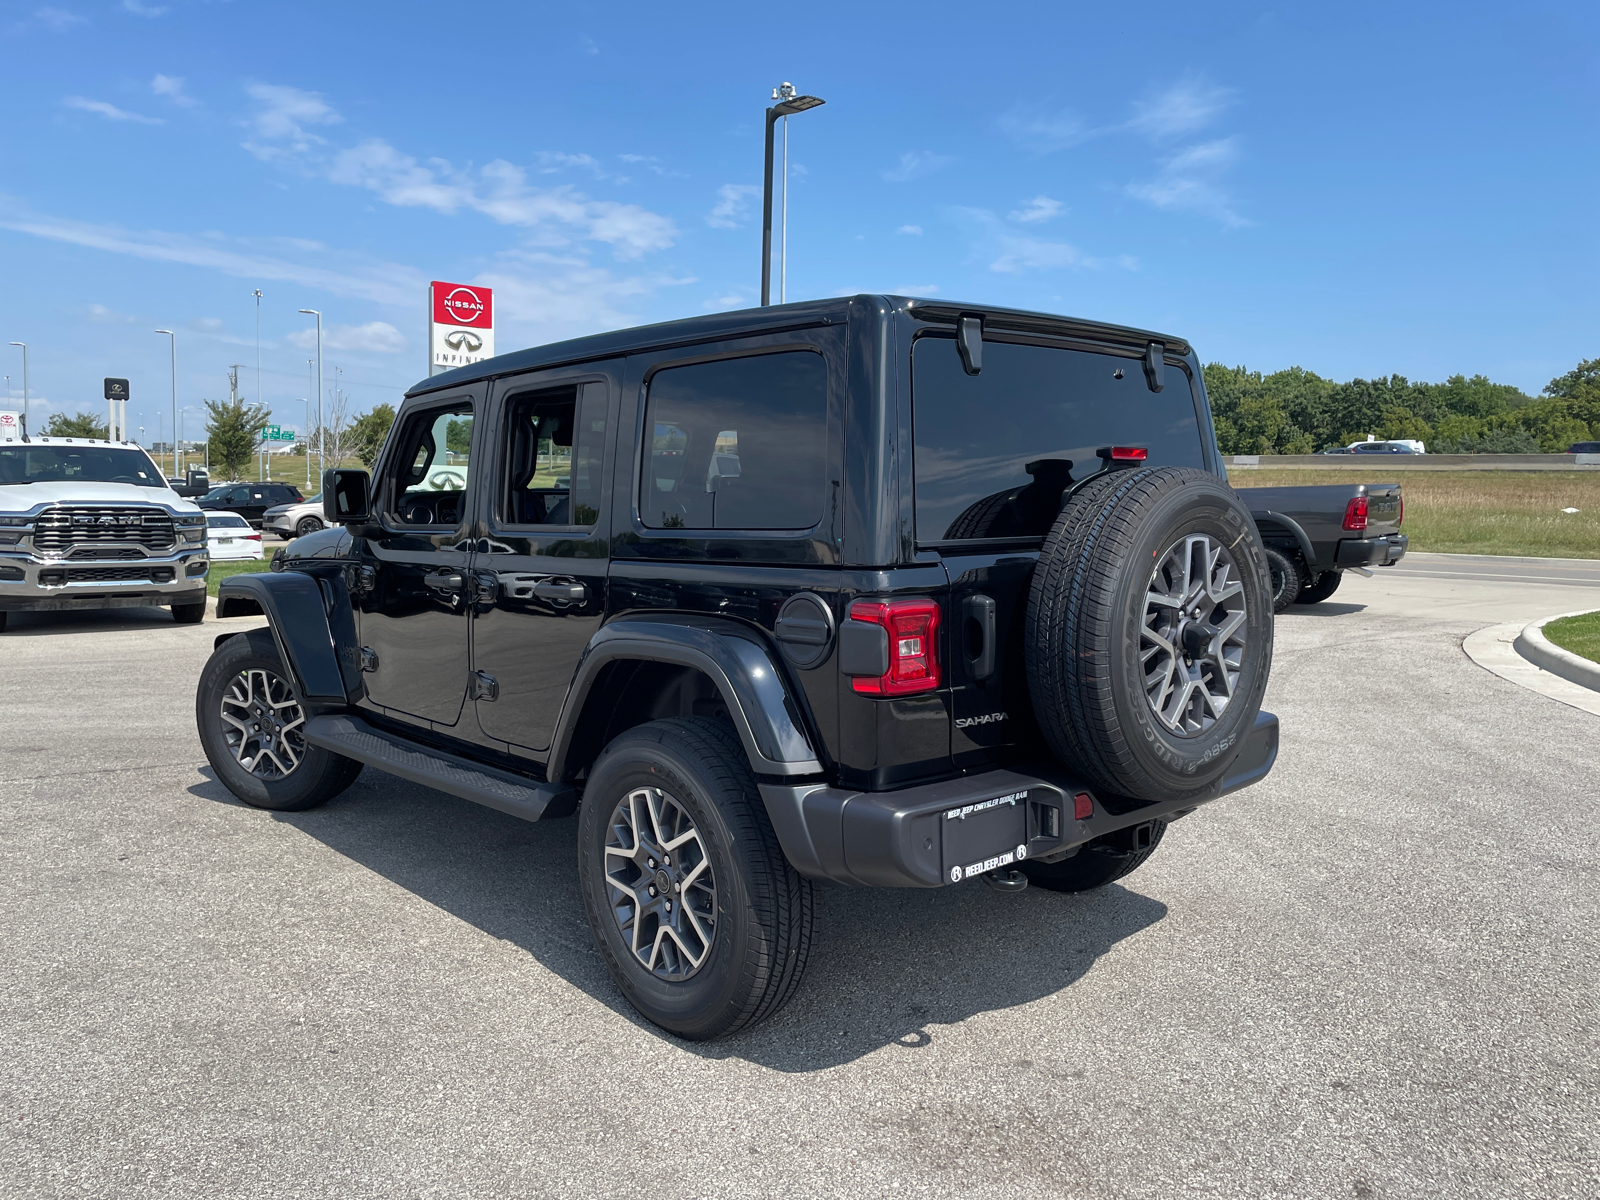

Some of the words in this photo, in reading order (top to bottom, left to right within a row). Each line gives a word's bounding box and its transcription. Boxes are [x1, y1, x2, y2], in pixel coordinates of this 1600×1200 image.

[444, 299, 484, 311] NISSAN
[72, 515, 140, 526] RAM
[955, 711, 1009, 728] SAHARA
[974, 799, 999, 812] CHRYSLER
[1015, 790, 1028, 800] RAM
[965, 852, 1014, 878] REEDJEEP.COM
